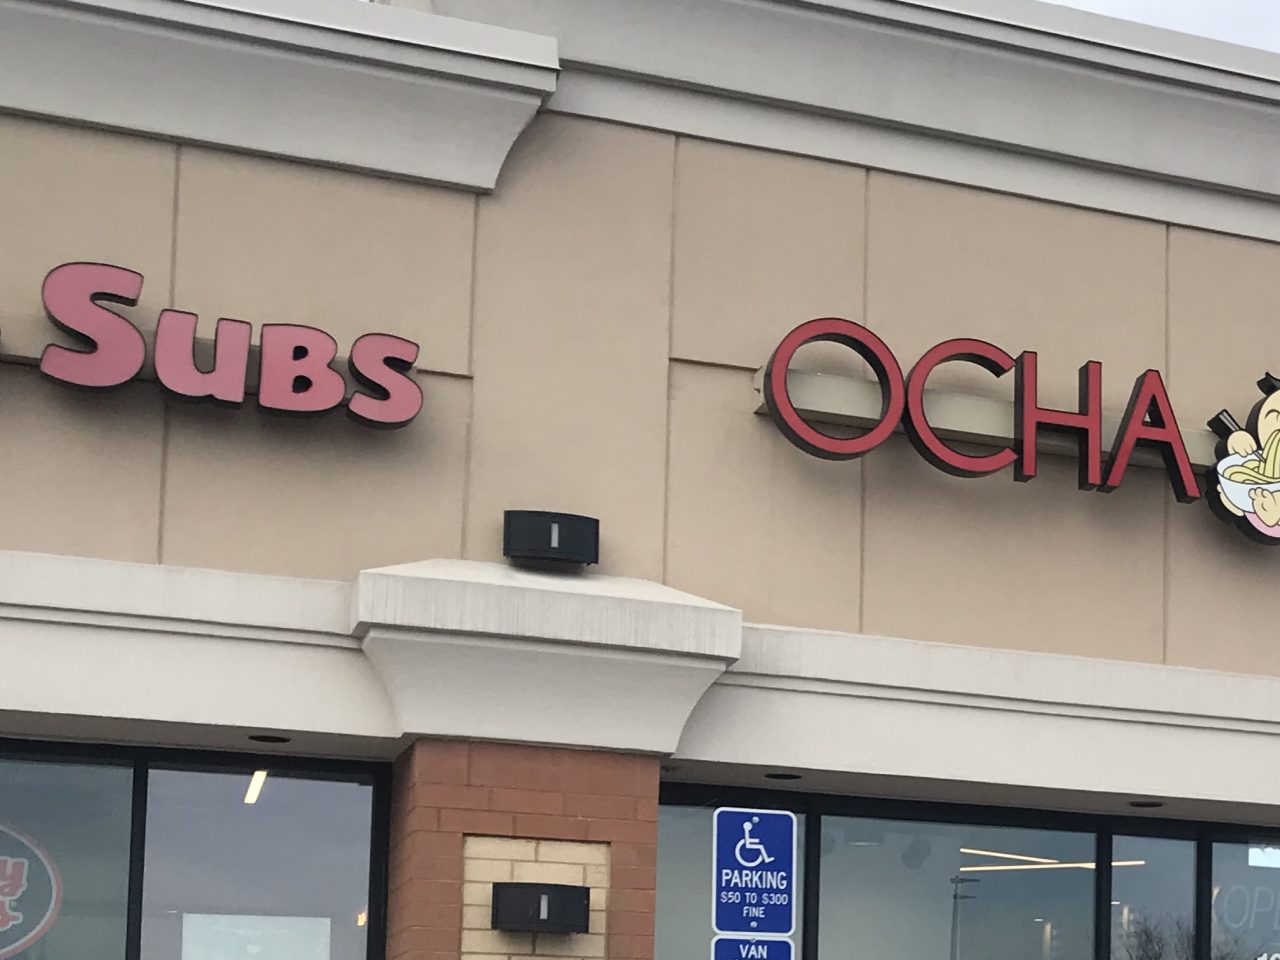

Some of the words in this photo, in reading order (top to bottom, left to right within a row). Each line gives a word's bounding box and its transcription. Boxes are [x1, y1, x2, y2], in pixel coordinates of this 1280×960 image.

[764, 317, 1201, 504] OCHA
[720, 868, 788, 890] PARKING
[745, 892, 758, 904] TO
[742, 906, 766, 918] FINE
[739, 944, 768, 959] VAN
